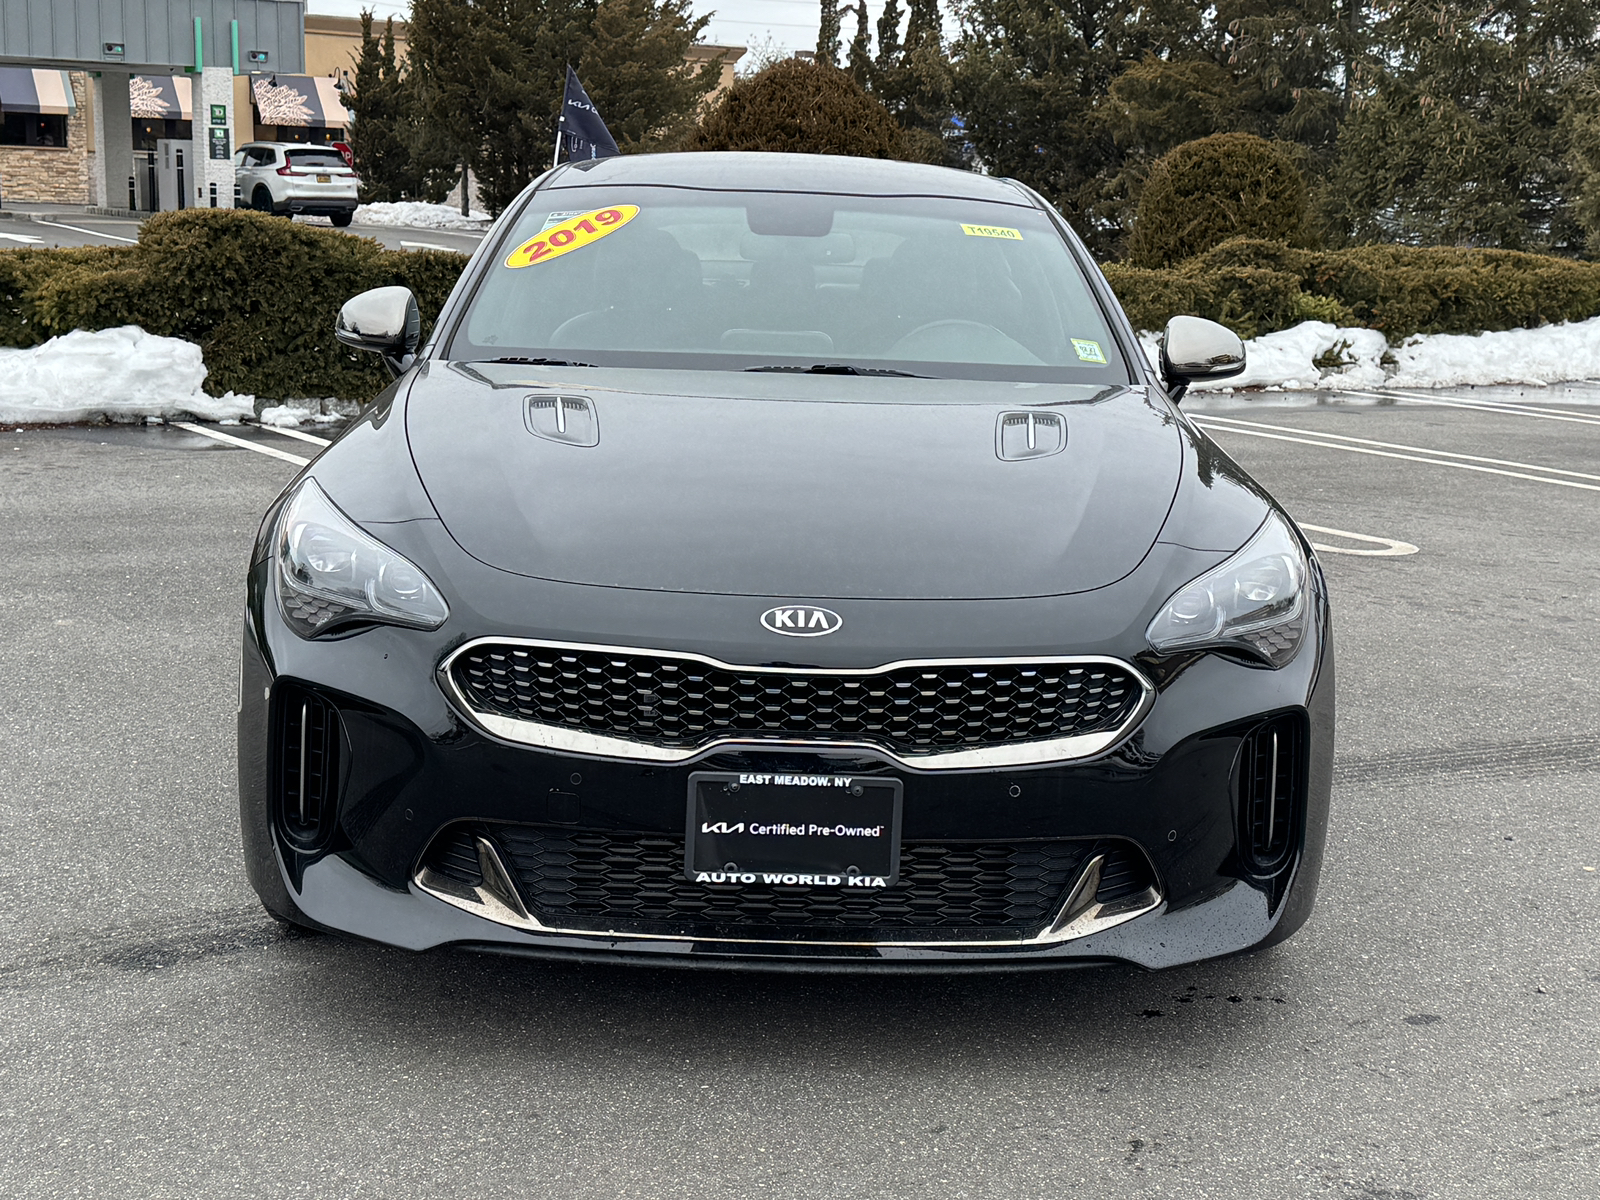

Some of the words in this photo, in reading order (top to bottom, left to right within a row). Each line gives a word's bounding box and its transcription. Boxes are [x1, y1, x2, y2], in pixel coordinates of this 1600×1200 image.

[523, 209, 624, 262] 2019
[967, 226, 1016, 238] T19540
[774, 609, 829, 629] KIA
[740, 774, 771, 785] EAST
[834, 777, 852, 788] NY
[750, 823, 805, 836] Certified
[696, 872, 756, 884] AUTO
[763, 874, 841, 886] WORLD
[848, 876, 886, 888] KIA
